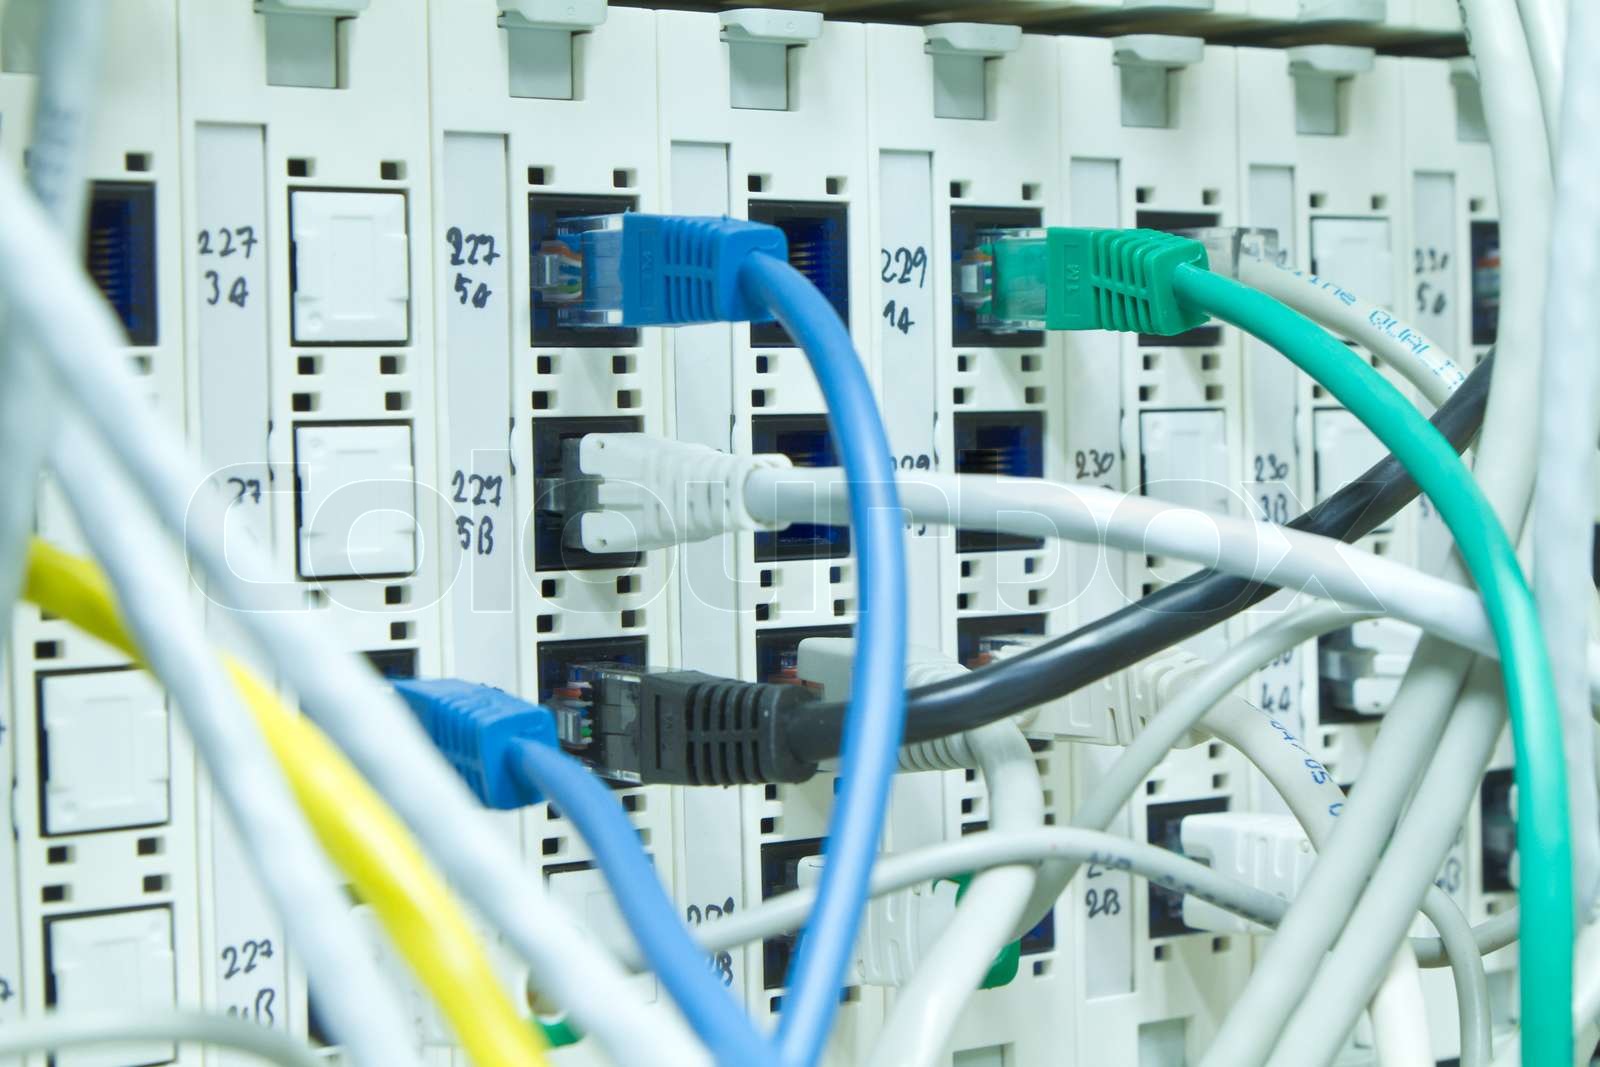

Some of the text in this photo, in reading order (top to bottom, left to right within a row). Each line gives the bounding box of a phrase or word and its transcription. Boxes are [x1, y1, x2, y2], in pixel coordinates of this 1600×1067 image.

[197, 225, 258, 259] 227
[446, 226, 501, 266] 227
[881, 246, 928, 289] 229
[1075, 449, 1115, 480] 230
[456, 515, 494, 555] 5B
[1085, 888, 1121, 918] 2B
[222, 938, 273, 980] 227
